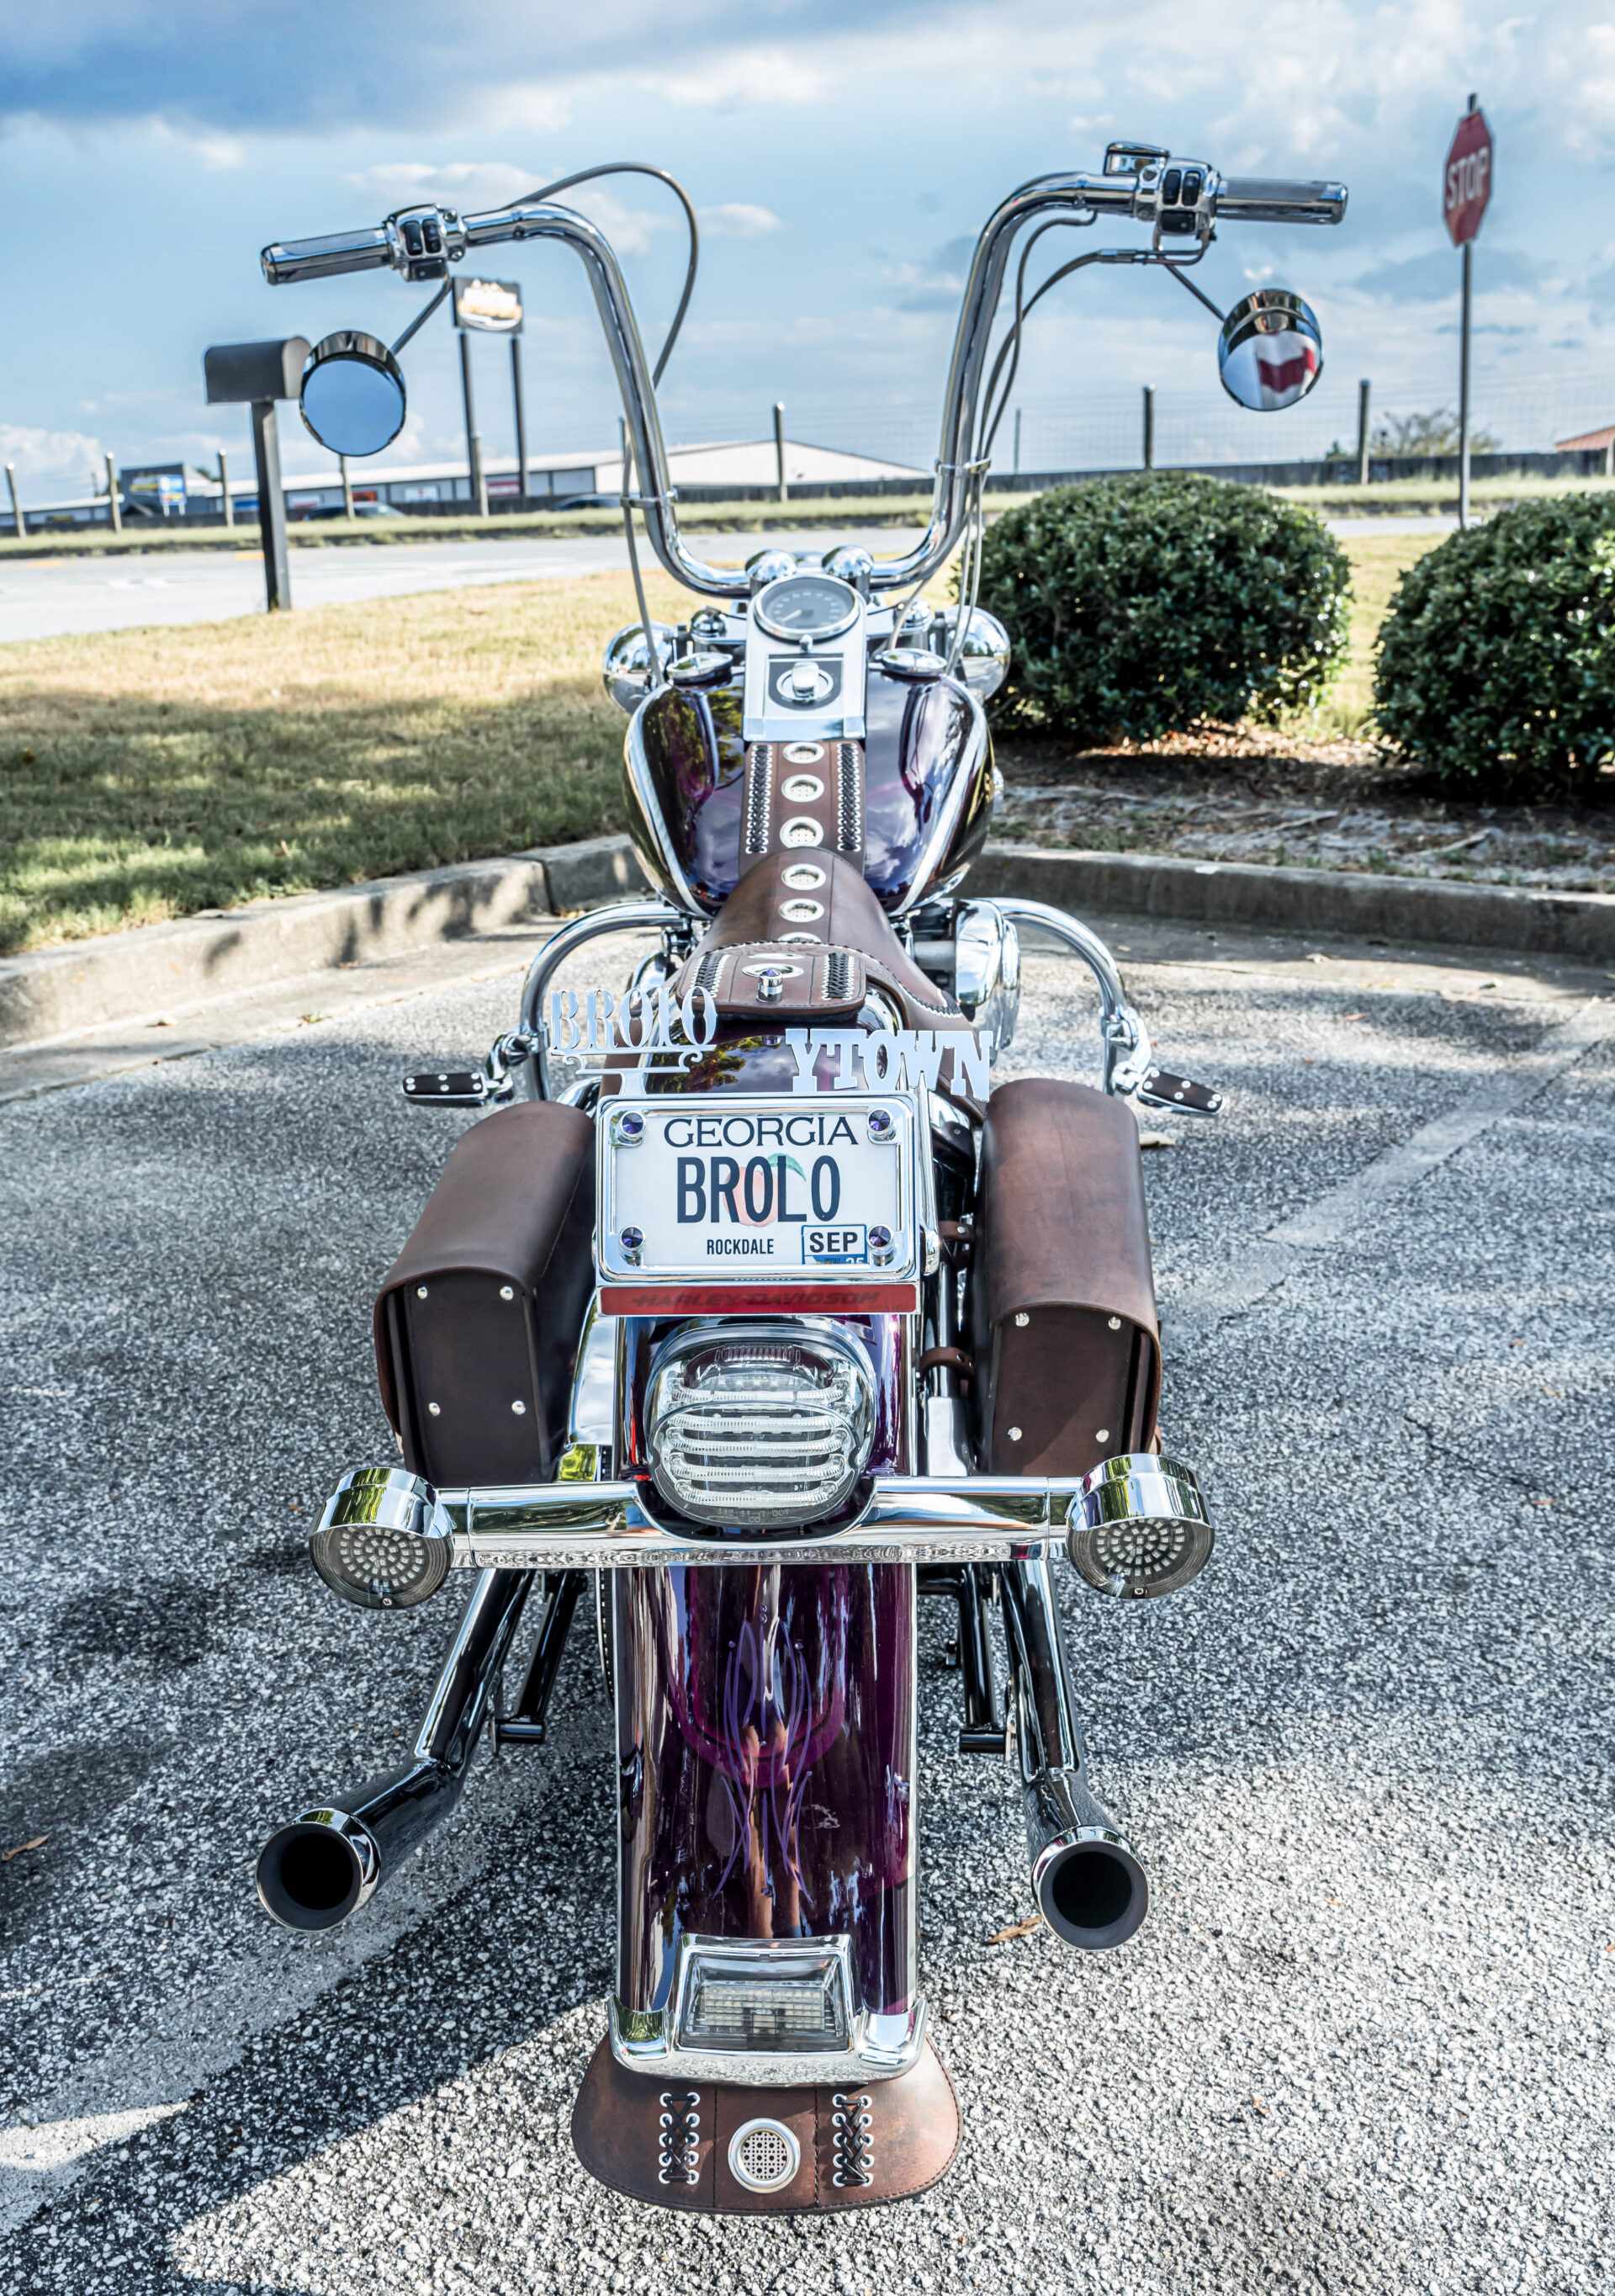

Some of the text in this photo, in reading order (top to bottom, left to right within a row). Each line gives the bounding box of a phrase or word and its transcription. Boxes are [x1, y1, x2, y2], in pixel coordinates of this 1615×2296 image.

[1446, 146, 1490, 209] STOP
[550, 985, 717, 1050] BROLO
[786, 1028, 993, 1102] YTOWN
[664, 1116, 859, 1148] GEORGIA
[677, 1155, 841, 1223] BROLO
[707, 1238, 774, 1255] ROCKDALE
[809, 1232, 858, 1253] SEP
[633, 1291, 880, 1307] HARLEY-DAVIDSON
